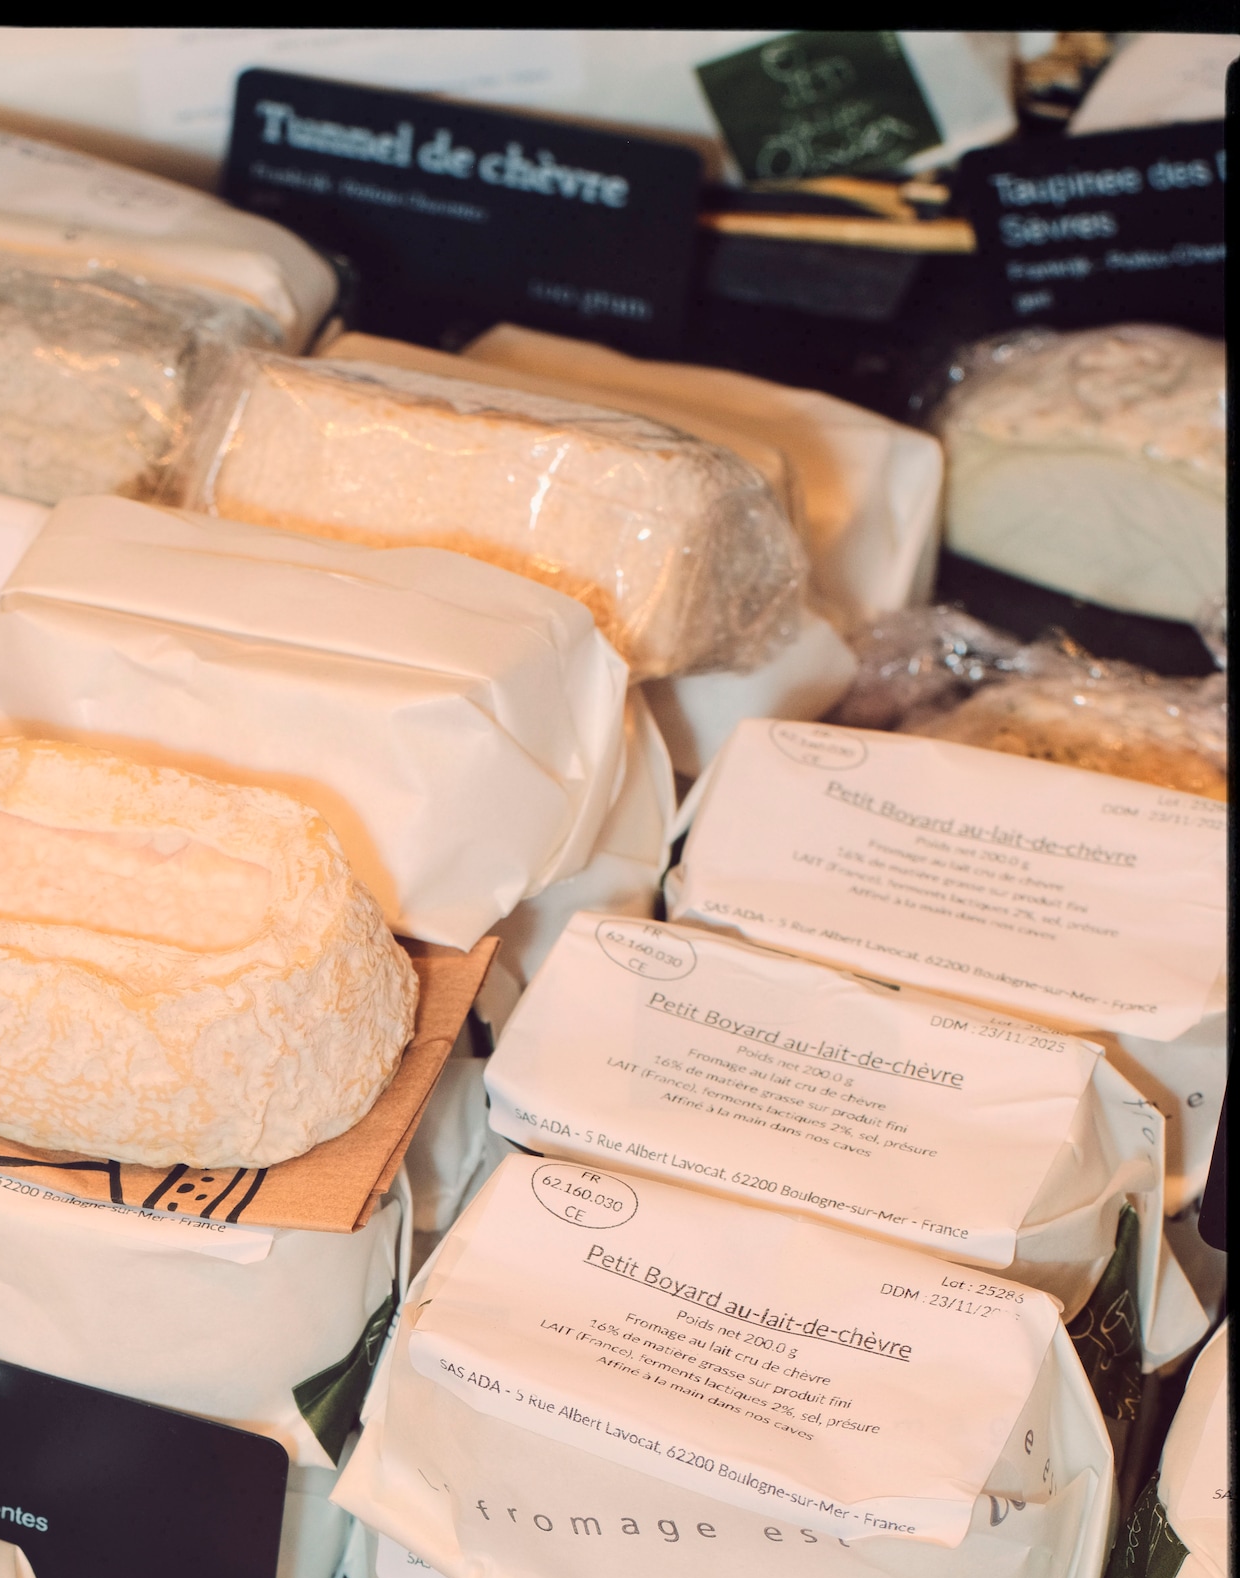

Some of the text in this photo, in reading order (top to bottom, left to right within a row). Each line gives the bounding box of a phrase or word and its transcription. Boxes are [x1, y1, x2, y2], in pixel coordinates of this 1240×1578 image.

[257, 101, 413, 169] Tunnel
[418, 128, 475, 178] de
[479, 143, 630, 208] chèvre
[825, 781, 1137, 867] Petit Boyard au-lait-de-chèvre
[605, 930, 683, 969] 62.160.030
[628, 957, 648, 974] CE
[819, 927, 862, 956] Albert
[925, 954, 971, 975] 62200
[974, 966, 1099, 1006] Boulogne-sur-Mer
[649, 991, 965, 1088] Petit Boyard au-lait-de-chèvre
[931, 1014, 968, 1032] DDM
[515, 1107, 537, 1125] SAS
[540, 1117, 572, 1137] ADA
[585, 1131, 593, 1143] 5
[597, 1134, 622, 1151] Rue
[626, 1138, 667, 1167] Albert
[731, 1170, 777, 1193] 62200
[780, 1184, 907, 1227] Boulogne-sur-Mer
[920, 1218, 970, 1240] France
[541, 1175, 623, 1213] 62.160.030
[581, 1171, 601, 1184] FR
[42, 1192, 168, 1222] Boulogne-sur-Mer
[179, 1218, 227, 1233] France
[565, 1205, 586, 1223] CE
[587, 1244, 913, 1359] Petit Boyard au-lait-de-chèvre
[881, 1283, 1021, 1321] DDM 23/11/2
[941, 1275, 963, 1289] Lot
[590, 1319, 853, 1410] 16% de matière grasse sur produit fini
[625, 1313, 831, 1386] Fromage au lait cru de chèvre
[677, 1310, 799, 1360] Poids net 200.0 g
[541, 1320, 574, 1336] LAIT
[640, 1353, 700, 1383] ferments
[704, 1376, 768, 1408] lactiques
[826, 1417, 881, 1436] présure
[597, 1355, 640, 1377] Affiné
[670, 1382, 704, 1400] main
[708, 1396, 743, 1417] dans
[745, 1410, 770, 1424] nos
[773, 1419, 815, 1442] caves
[440, 1357, 465, 1380] SAS
[468, 1371, 500, 1395] ADA
[516, 1389, 525, 1402] 5
[529, 1392, 555, 1415] Rue
[558, 1403, 602, 1432] Albert
[666, 1445, 715, 1473] 62200
[718, 1463, 850, 1520] Boulogne-sur-Mer
[864, 1512, 915, 1534] France
[475, 1499, 717, 1543] fromage
